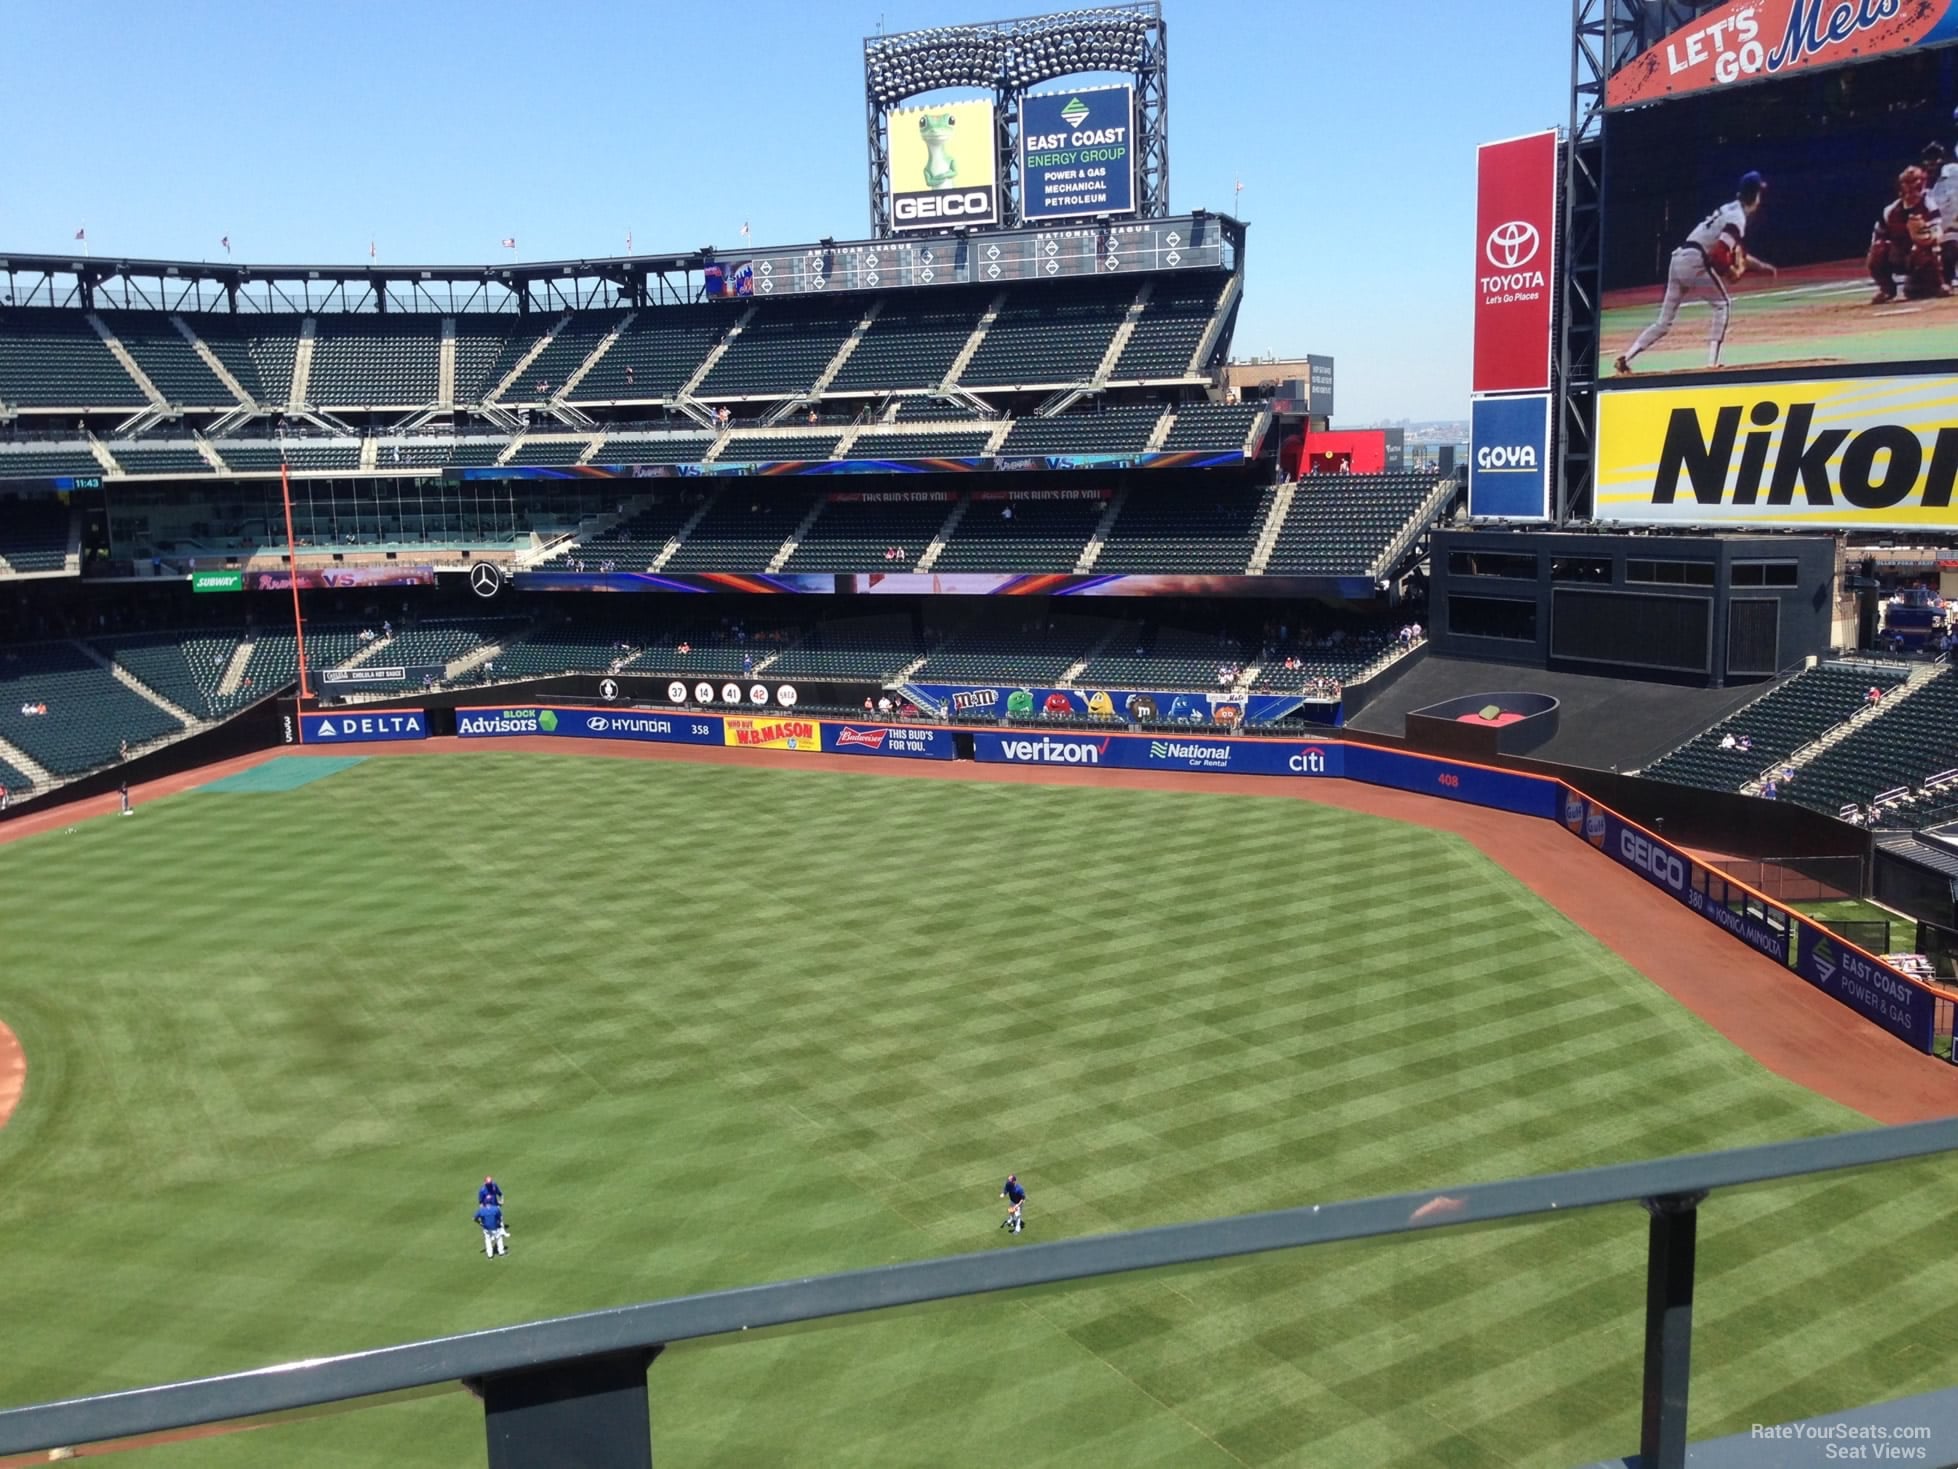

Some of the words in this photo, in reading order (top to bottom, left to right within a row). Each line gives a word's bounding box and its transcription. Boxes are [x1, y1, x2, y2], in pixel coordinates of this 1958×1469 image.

[1666, 8, 1759, 75] LET'S
[1713, 40, 1764, 84] GO
[1027, 133, 1067, 151] EAST
[1071, 128, 1125, 147] COAST
[1027, 152, 1076, 168] ENERGY
[1080, 147, 1126, 164] GROUP
[1044, 169, 1076, 181] POWER
[1078, 169, 1086, 178] &
[1087, 167, 1106, 177] GAS
[1044, 181, 1107, 193] MECHANICAL
[894, 191, 989, 219] GEICO
[1044, 194, 1107, 207] PETROLEUM
[1037, 230, 1096, 239] NATIONAL
[1103, 225, 1150, 235] LEAGUE
[807, 247, 863, 255] AMERICAN
[869, 244, 912, 252] LEAGUE
[1480, 271, 1544, 293] TOYOTA
[1485, 296, 1502, 305] Let's
[1503, 294, 1513, 303] Go
[1514, 292, 1539, 302] Places
[1478, 446, 1535, 468] GOYA
[75, 479, 99, 488] 11:43
[863, 493, 881, 502] THIS
[883, 492, 909, 502] BUD'S
[911, 491, 928, 501] FOR
[929, 491, 948, 501] YOU
[1008, 491, 1029, 500] THIS
[1031, 491, 1059, 500] BUD'S
[1061, 490, 1079, 500] FOR
[1080, 489, 1101, 498] YOU
[197, 577, 237, 587] SUBWAY
[323, 574, 355, 587] VS
[671, 688, 683, 698] 37
[699, 687, 709, 698] 14
[727, 688, 737, 699] 41
[753, 689, 765, 700] 42
[503, 710, 536, 719] BLOCK
[343, 717, 420, 734] DELTA
[459, 717, 537, 734] Advisors
[611, 718, 671, 733] HYUNDAI
[691, 725, 709, 736] 358
[840, 731, 883, 743] Budweiser
[889, 728, 907, 739] THIS
[908, 730, 934, 741] BUD'S
[889, 740, 905, 750] FOR
[906, 741, 926, 752] YOU.
[1001, 737, 1098, 763] verizon
[1167, 743, 1230, 760] National
[1189, 759, 1202, 767] Car
[1203, 760, 1228, 768] Rental
[1288, 750, 1325, 772] citi
[1438, 774, 1459, 788] 408
[1588, 818, 1605, 834] Gulf
[1620, 828, 1684, 891] GEICO
[1688, 889, 1703, 911] 380
[1715, 907, 1746, 937] KONICA
[1746, 928, 1782, 959] MINOLTA
[1842, 953, 1871, 981] EAST
[1873, 970, 1913, 1006] COAST
[1841, 975, 1880, 1008] POWER
[1889, 1005, 1912, 1029] GAS
